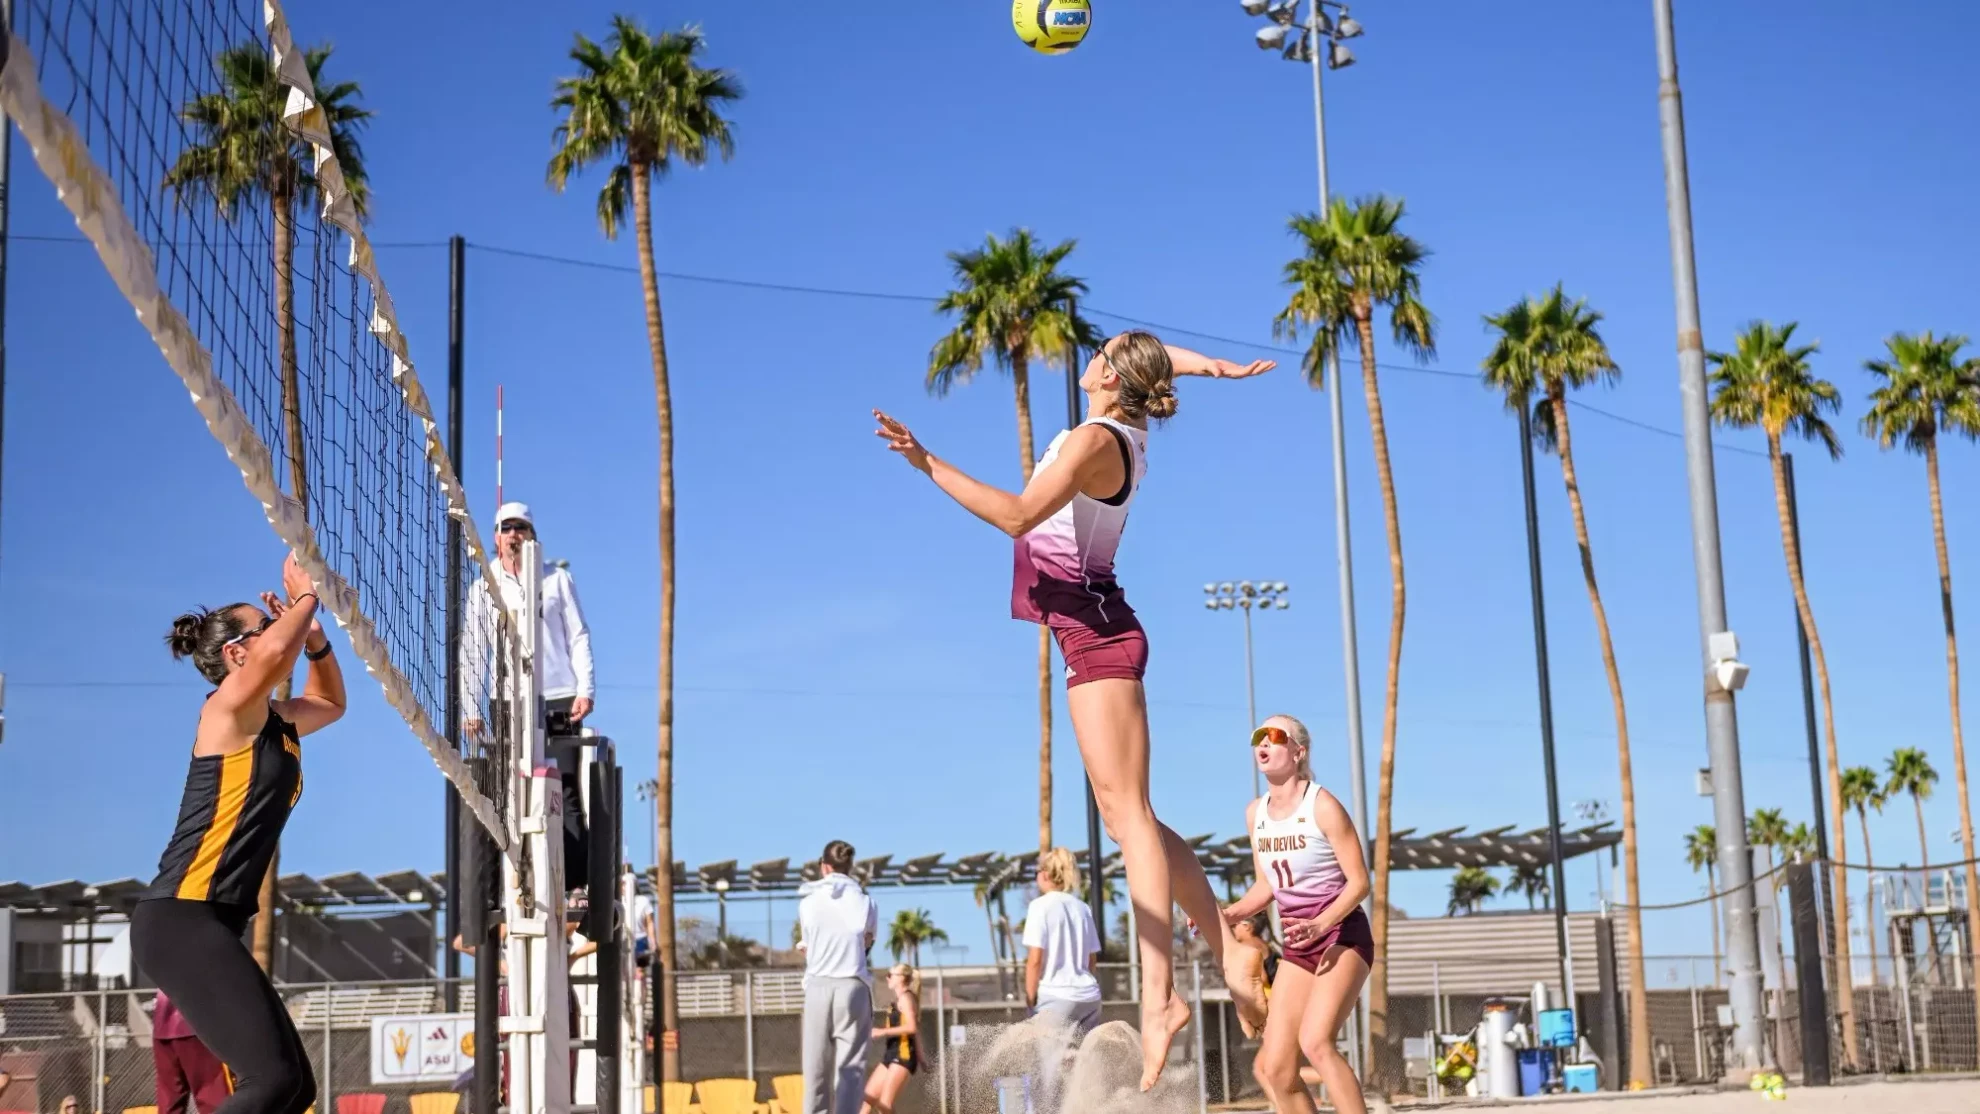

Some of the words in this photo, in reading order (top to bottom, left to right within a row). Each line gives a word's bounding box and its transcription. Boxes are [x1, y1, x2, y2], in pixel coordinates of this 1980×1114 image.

[1258, 837, 1272, 853] SUN
[1273, 834, 1307, 853] DEVILS
[1271, 859, 1295, 889] 11
[425, 1055, 451, 1065] ASU
